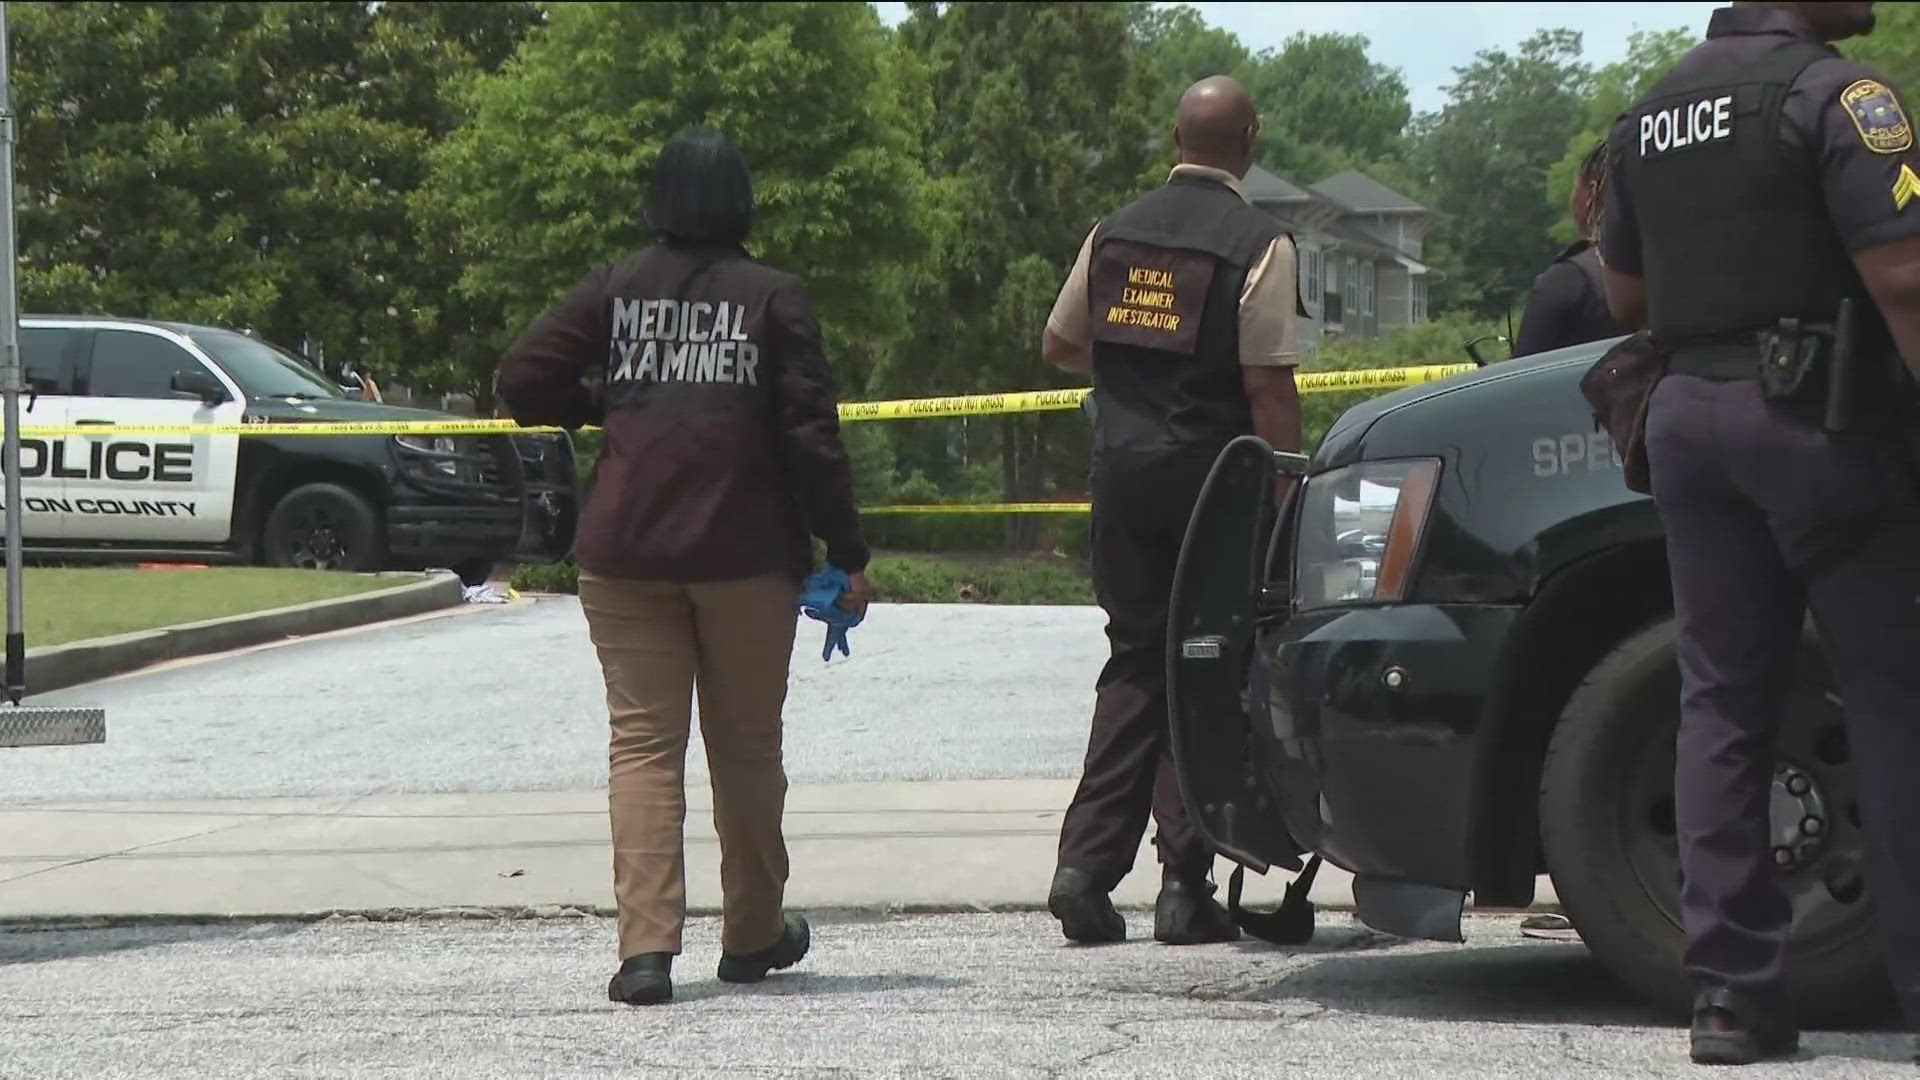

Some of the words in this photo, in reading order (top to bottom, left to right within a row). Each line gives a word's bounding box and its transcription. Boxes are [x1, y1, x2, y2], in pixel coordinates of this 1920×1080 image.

[1640, 95, 1732, 156] POLICE
[1128, 266, 1174, 288] MEDICAL
[1122, 287, 1175, 309] EXAMINER
[611, 297, 748, 342] MEDICAL
[1107, 307, 1180, 331] INVESTIGATOR
[608, 340, 759, 386] XAMINER
[1300, 375, 1327, 389] POLICE
[1330, 374, 1347, 386] LINE
[1349, 373, 1360, 385] DO
[1362, 372, 1377, 384] NOT
[1379, 370, 1406, 383] CROSS
[856, 404, 879, 416] CROSS
[909, 401, 934, 414] POLICE
[935, 399, 951, 412] LINE
[953, 398, 962, 411] DO
[965, 397, 978, 409] NOT
[980, 396, 1004, 409] CROSS
[1035, 393, 1060, 406] POLICE
[1, 439, 193, 482] OLICE
[75, 498, 196, 516] COUNTY
